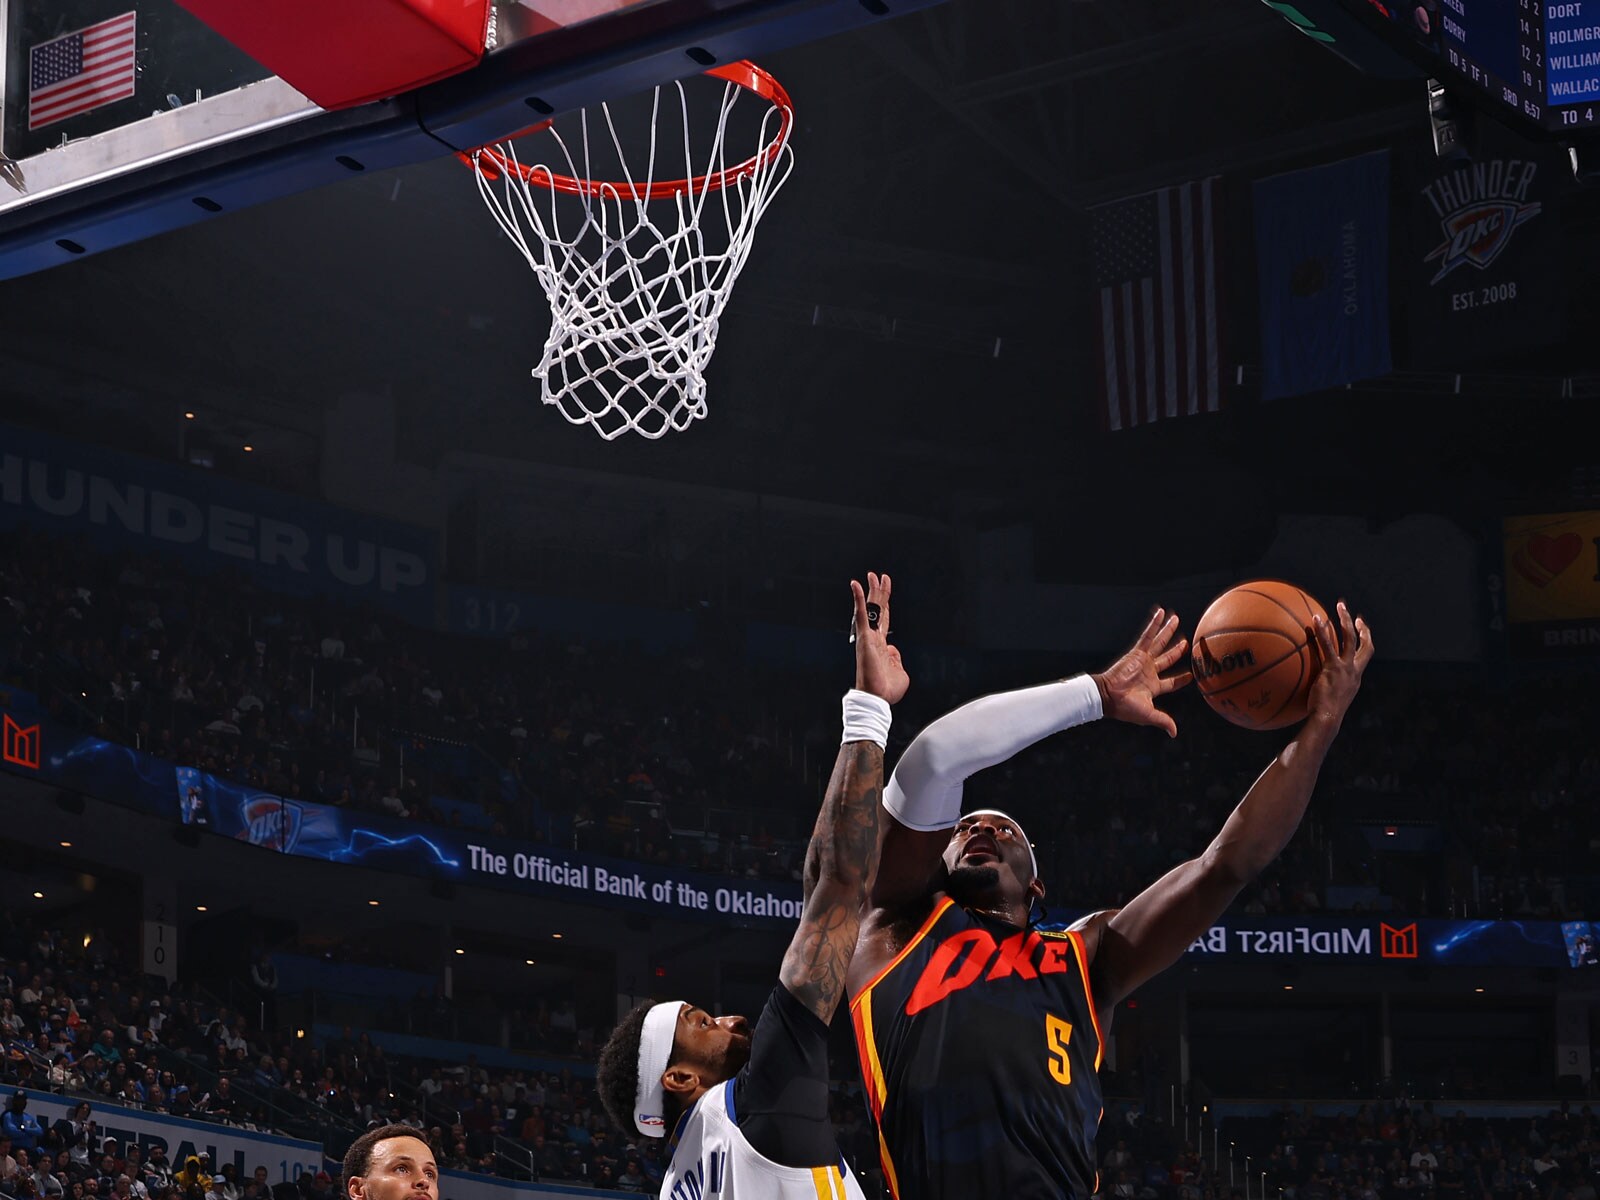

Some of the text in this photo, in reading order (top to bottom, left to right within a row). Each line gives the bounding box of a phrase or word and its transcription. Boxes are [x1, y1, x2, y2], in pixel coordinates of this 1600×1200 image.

[1534, 2, 1539, 16] 2
[1548, 3, 1582, 19] DORT
[1520, 19, 1540, 41] 14 1
[1549, 26, 1600, 45] HOLMGR
[1443, 16, 1542, 93] CURRY 19 1
[1521, 45, 1531, 61] 12
[1536, 53, 1542, 67] 2
[1550, 52, 1600, 71] WILLIAM
[1449, 48, 1541, 120] TO 5 TF 1 3RD 6:57
[1551, 78, 1600, 97] WALLAC
[1561, 108, 1594, 125] TO 4
[1421, 160, 1537, 218] THUNDER
[1448, 210, 1502, 261] OKC
[1343, 218, 1359, 316] OKLAHOMA
[1452, 281, 1517, 311] EST. 2008
[327, 533, 427, 592] UP
[464, 598, 521, 633] 312
[467, 844, 507, 876] The
[513, 852, 588, 890] Official
[594, 866, 647, 900] Bank
[652, 880, 673, 903] of
[677, 883, 708, 911] the
[906, 928, 1069, 1016] OKC
[1045, 1013, 1073, 1085] 5
